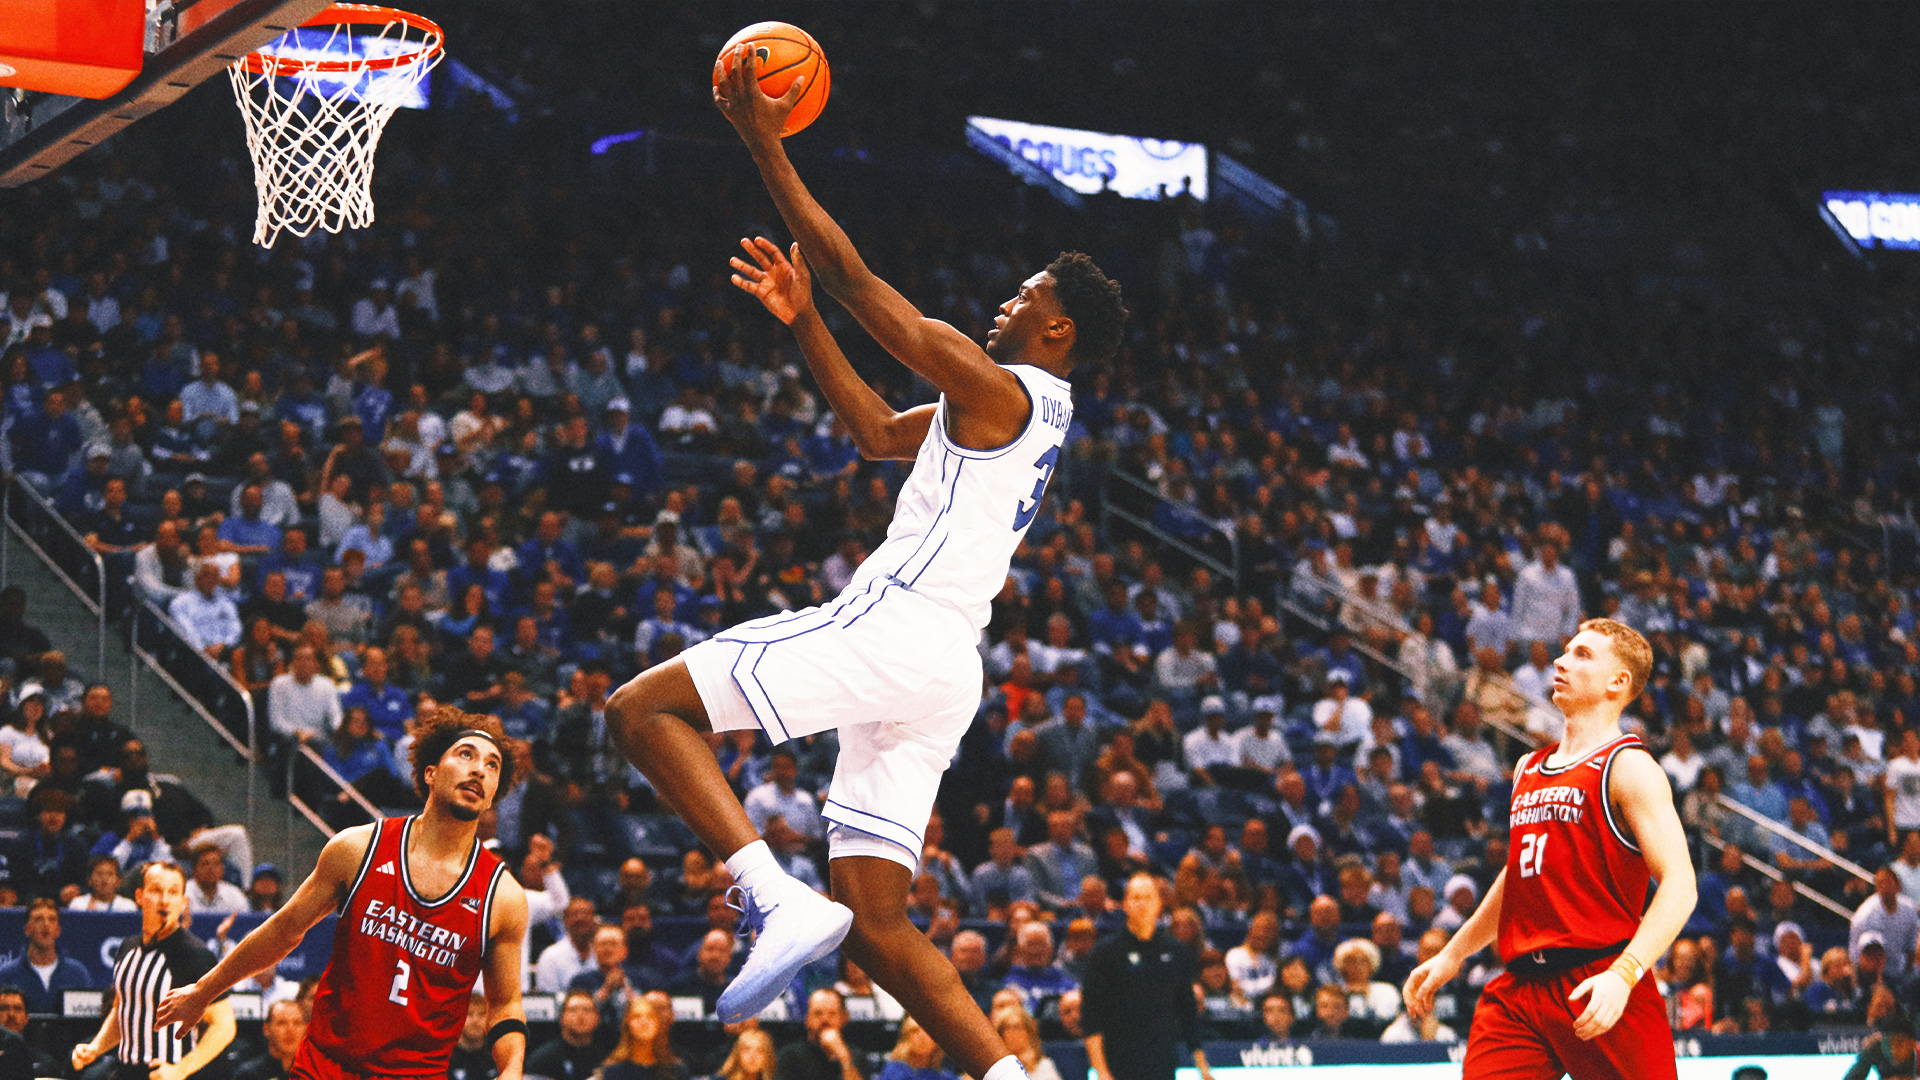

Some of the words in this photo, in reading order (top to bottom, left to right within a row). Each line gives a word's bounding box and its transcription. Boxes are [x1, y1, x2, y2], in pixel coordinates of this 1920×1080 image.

[1018, 138, 1117, 182] COUGS
[1012, 444, 1060, 532] 3
[1511, 786, 1586, 812] EASTERN
[1519, 832, 1548, 879] 21
[365, 899, 468, 950] EASTERN
[388, 959, 410, 1007] 2
